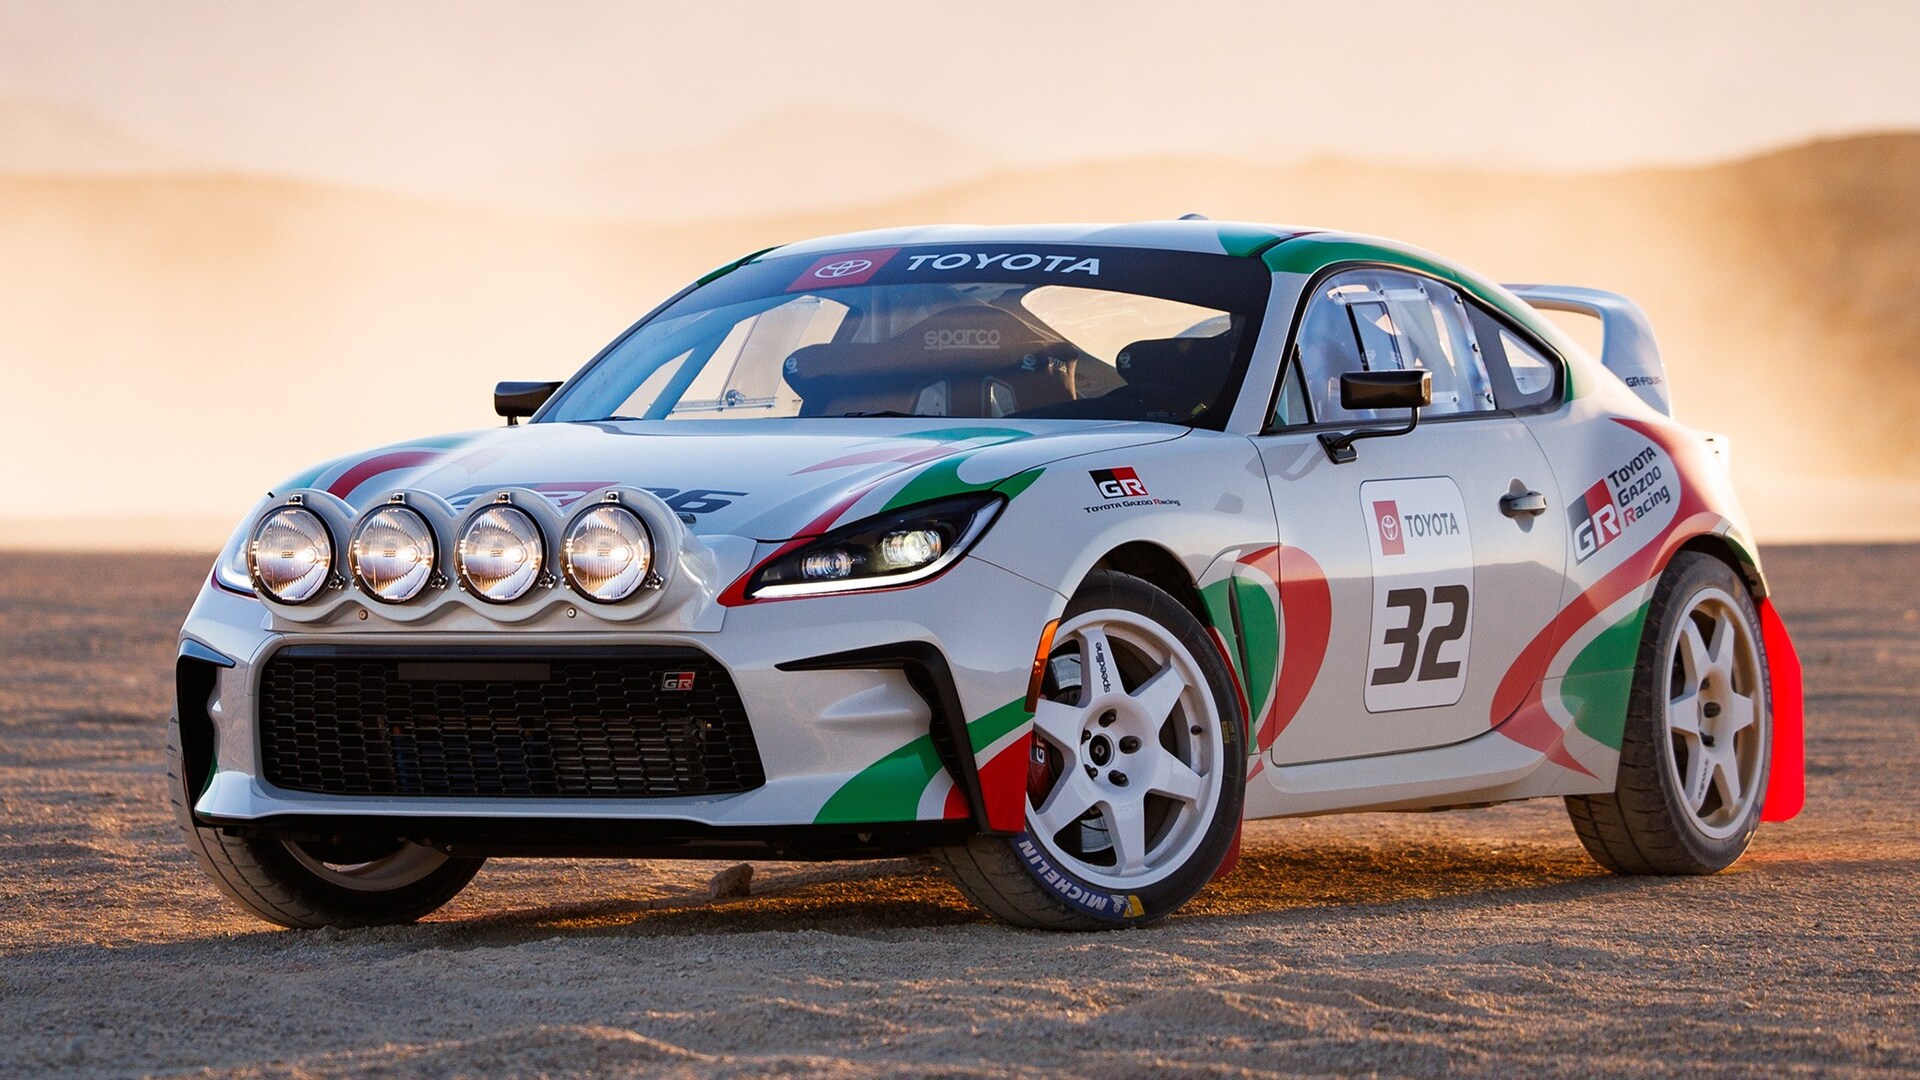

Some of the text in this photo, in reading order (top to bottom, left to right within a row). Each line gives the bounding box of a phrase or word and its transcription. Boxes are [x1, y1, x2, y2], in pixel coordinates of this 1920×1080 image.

[907, 253, 1100, 276] TOYOTA
[925, 329, 1000, 350] sparco
[1098, 478, 1147, 498] GR
[1607, 446, 1657, 488] TOYOTA
[1617, 465, 1662, 508] GAZOO
[1083, 498, 1181, 514] TOYOTA GAZOO Racing
[1404, 512, 1460, 538] TOYOTA
[1622, 485, 1671, 527] Racing
[1573, 503, 1620, 561] GR
[1370, 584, 1470, 687] 32
[664, 678, 692, 689] GR
[1095, 641, 1111, 693] speedline
[1018, 840, 1108, 911] MICHELIN
